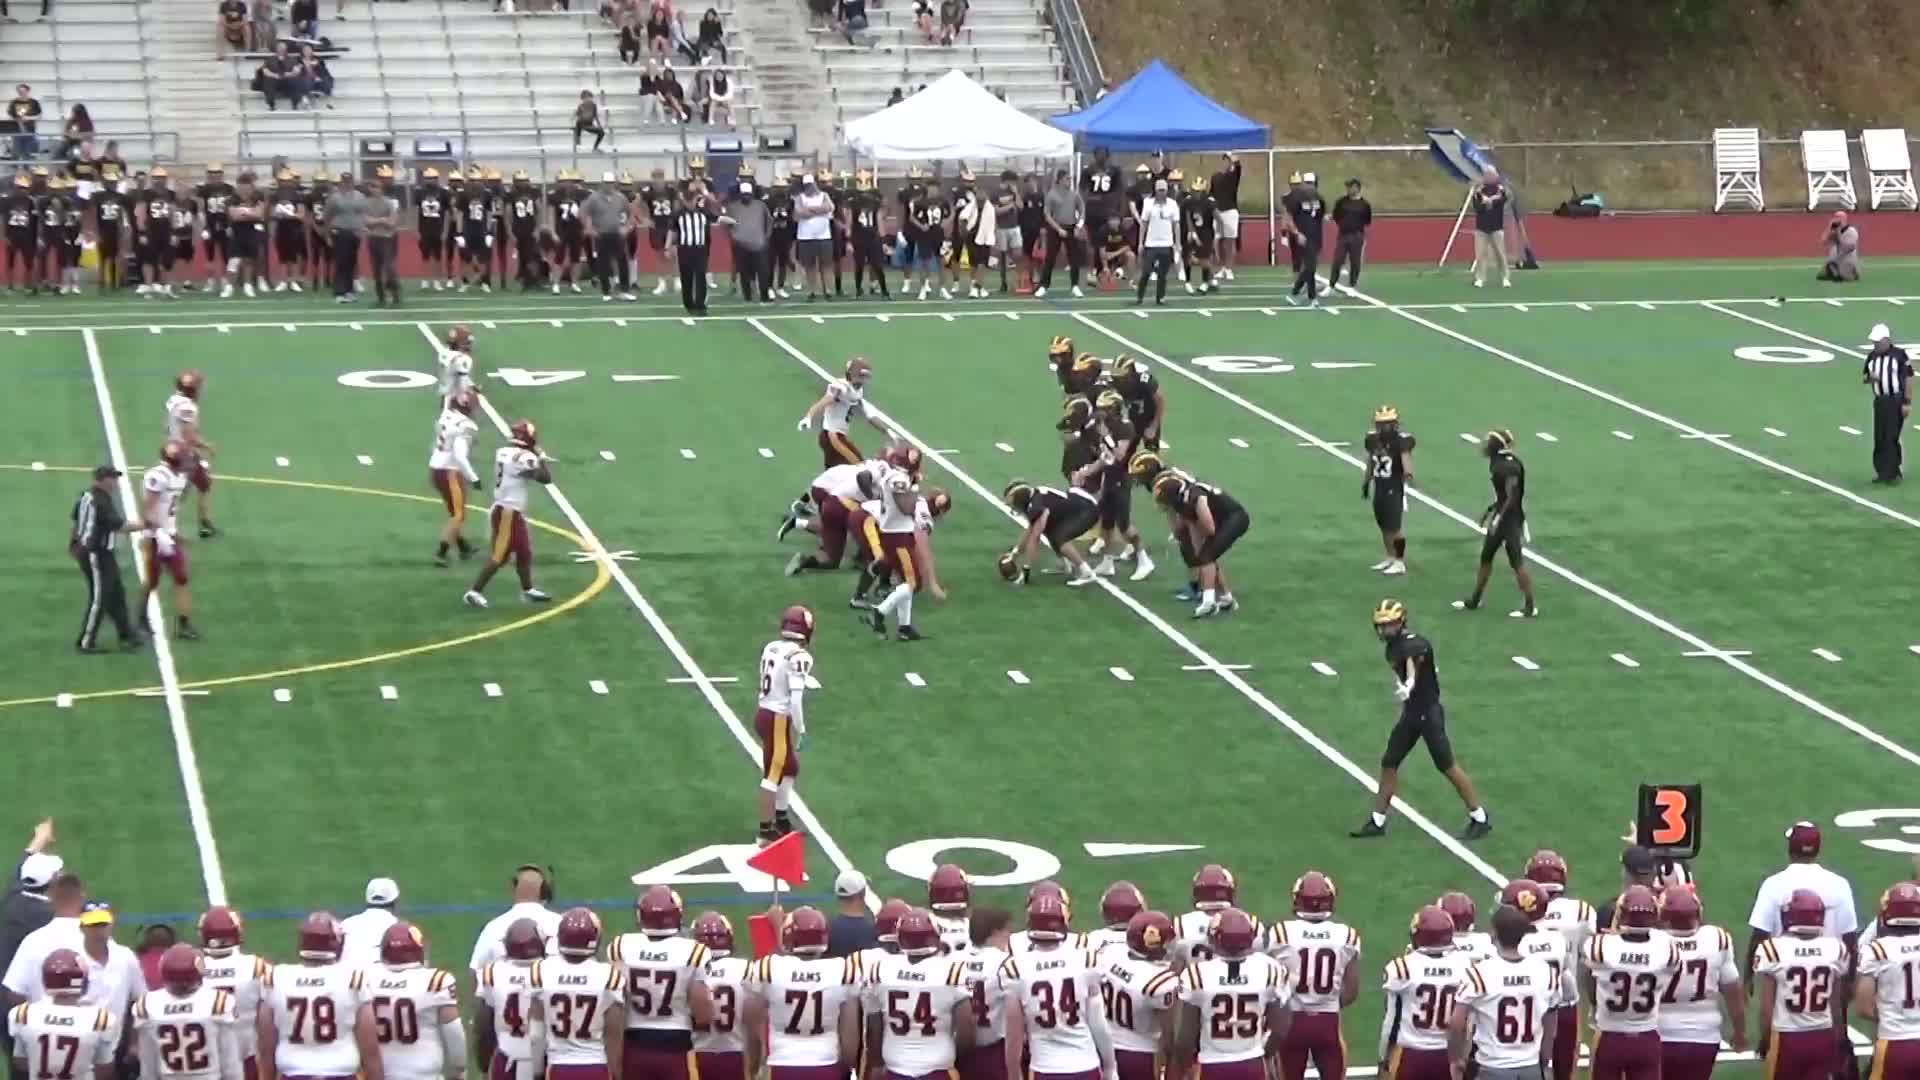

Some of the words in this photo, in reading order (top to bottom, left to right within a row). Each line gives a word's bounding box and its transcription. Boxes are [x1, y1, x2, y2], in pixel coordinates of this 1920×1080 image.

[1091, 175, 1111, 192] 76
[1652, 789, 1688, 844] 3
[639, 950, 668, 962] RAMS
[1302, 930, 1331, 940] RAMS
[558, 974, 588, 985] RAMS
[791, 971, 822, 983] RAMS
[1297, 947, 1337, 994] 10
[1423, 967, 1453, 977] RAMS
[1503, 975, 1532, 987] RAMS
[1619, 952, 1650, 965] RAMS
[1660, 959, 1708, 1003] 77
[629, 968, 677, 1017] 57
[1031, 977, 1080, 1029] 34
[1412, 983, 1457, 1030] 30
[1606, 971, 1657, 1012] 33
[1784, 966, 1831, 1012] 32
[286, 996, 337, 1045] 78
[373, 996, 418, 1045] 50
[550, 993, 599, 1040] 37
[784, 990, 825, 1035] 71
[888, 990, 937, 1037] 54
[1211, 993, 1260, 1040] 25
[1496, 995, 1535, 1044] 61
[37, 1034, 80, 1080] 17
[158, 1022, 209, 1072] 22
